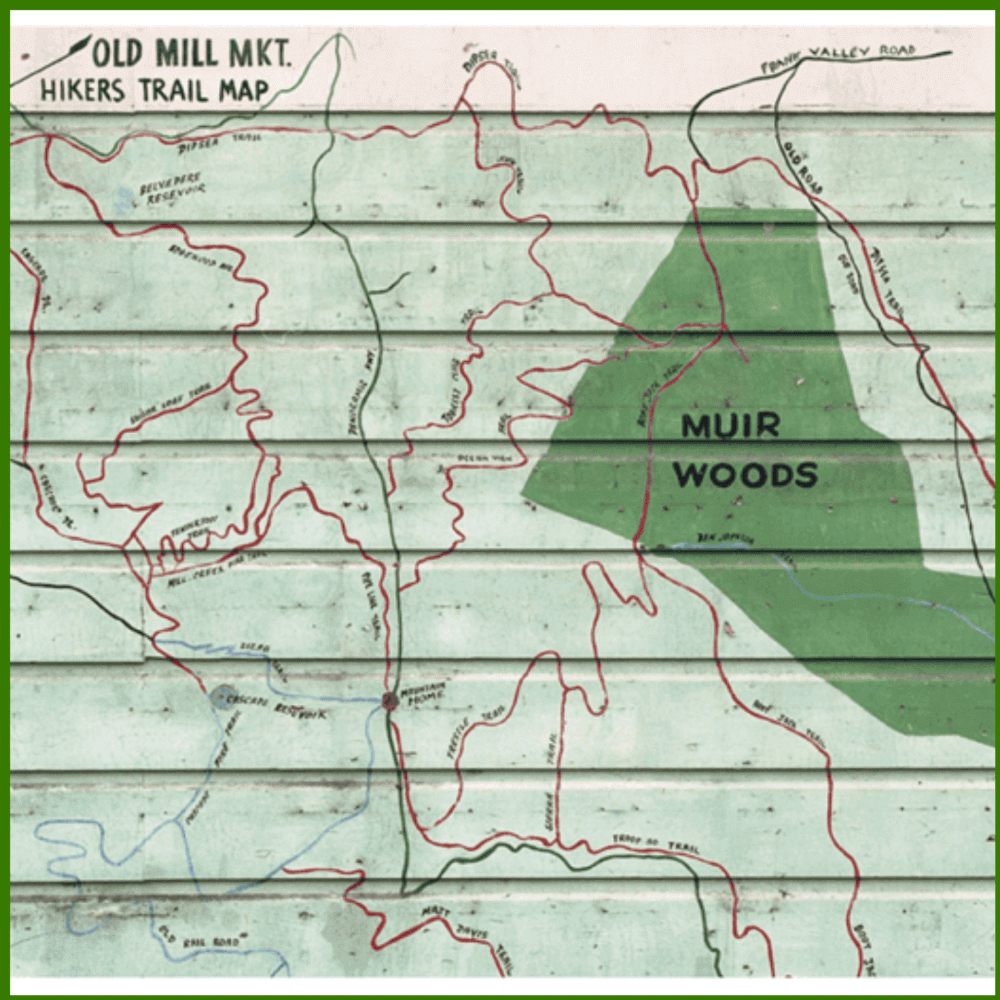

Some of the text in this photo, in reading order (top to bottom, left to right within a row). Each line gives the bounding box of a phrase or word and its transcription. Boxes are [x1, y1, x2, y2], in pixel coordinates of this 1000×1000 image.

[92, 38, 292, 67] OLD MILL MKT.
[760, 44, 916, 74] FRANK VALLEY ROAD
[41, 78, 269, 102] HIKERS TRAIL MAP
[177, 138, 219, 155] DIPSEA
[784, 142, 823, 195] OLD ROAD
[682, 412, 781, 437] MUIR
[672, 462, 819, 487] WOODS
[400, 681, 446, 699] MOUNTAIN
[446, 718, 469, 759] TRESTLE
[422, 905, 451, 918] MATT
[456, 924, 489, 940] DAVIS
